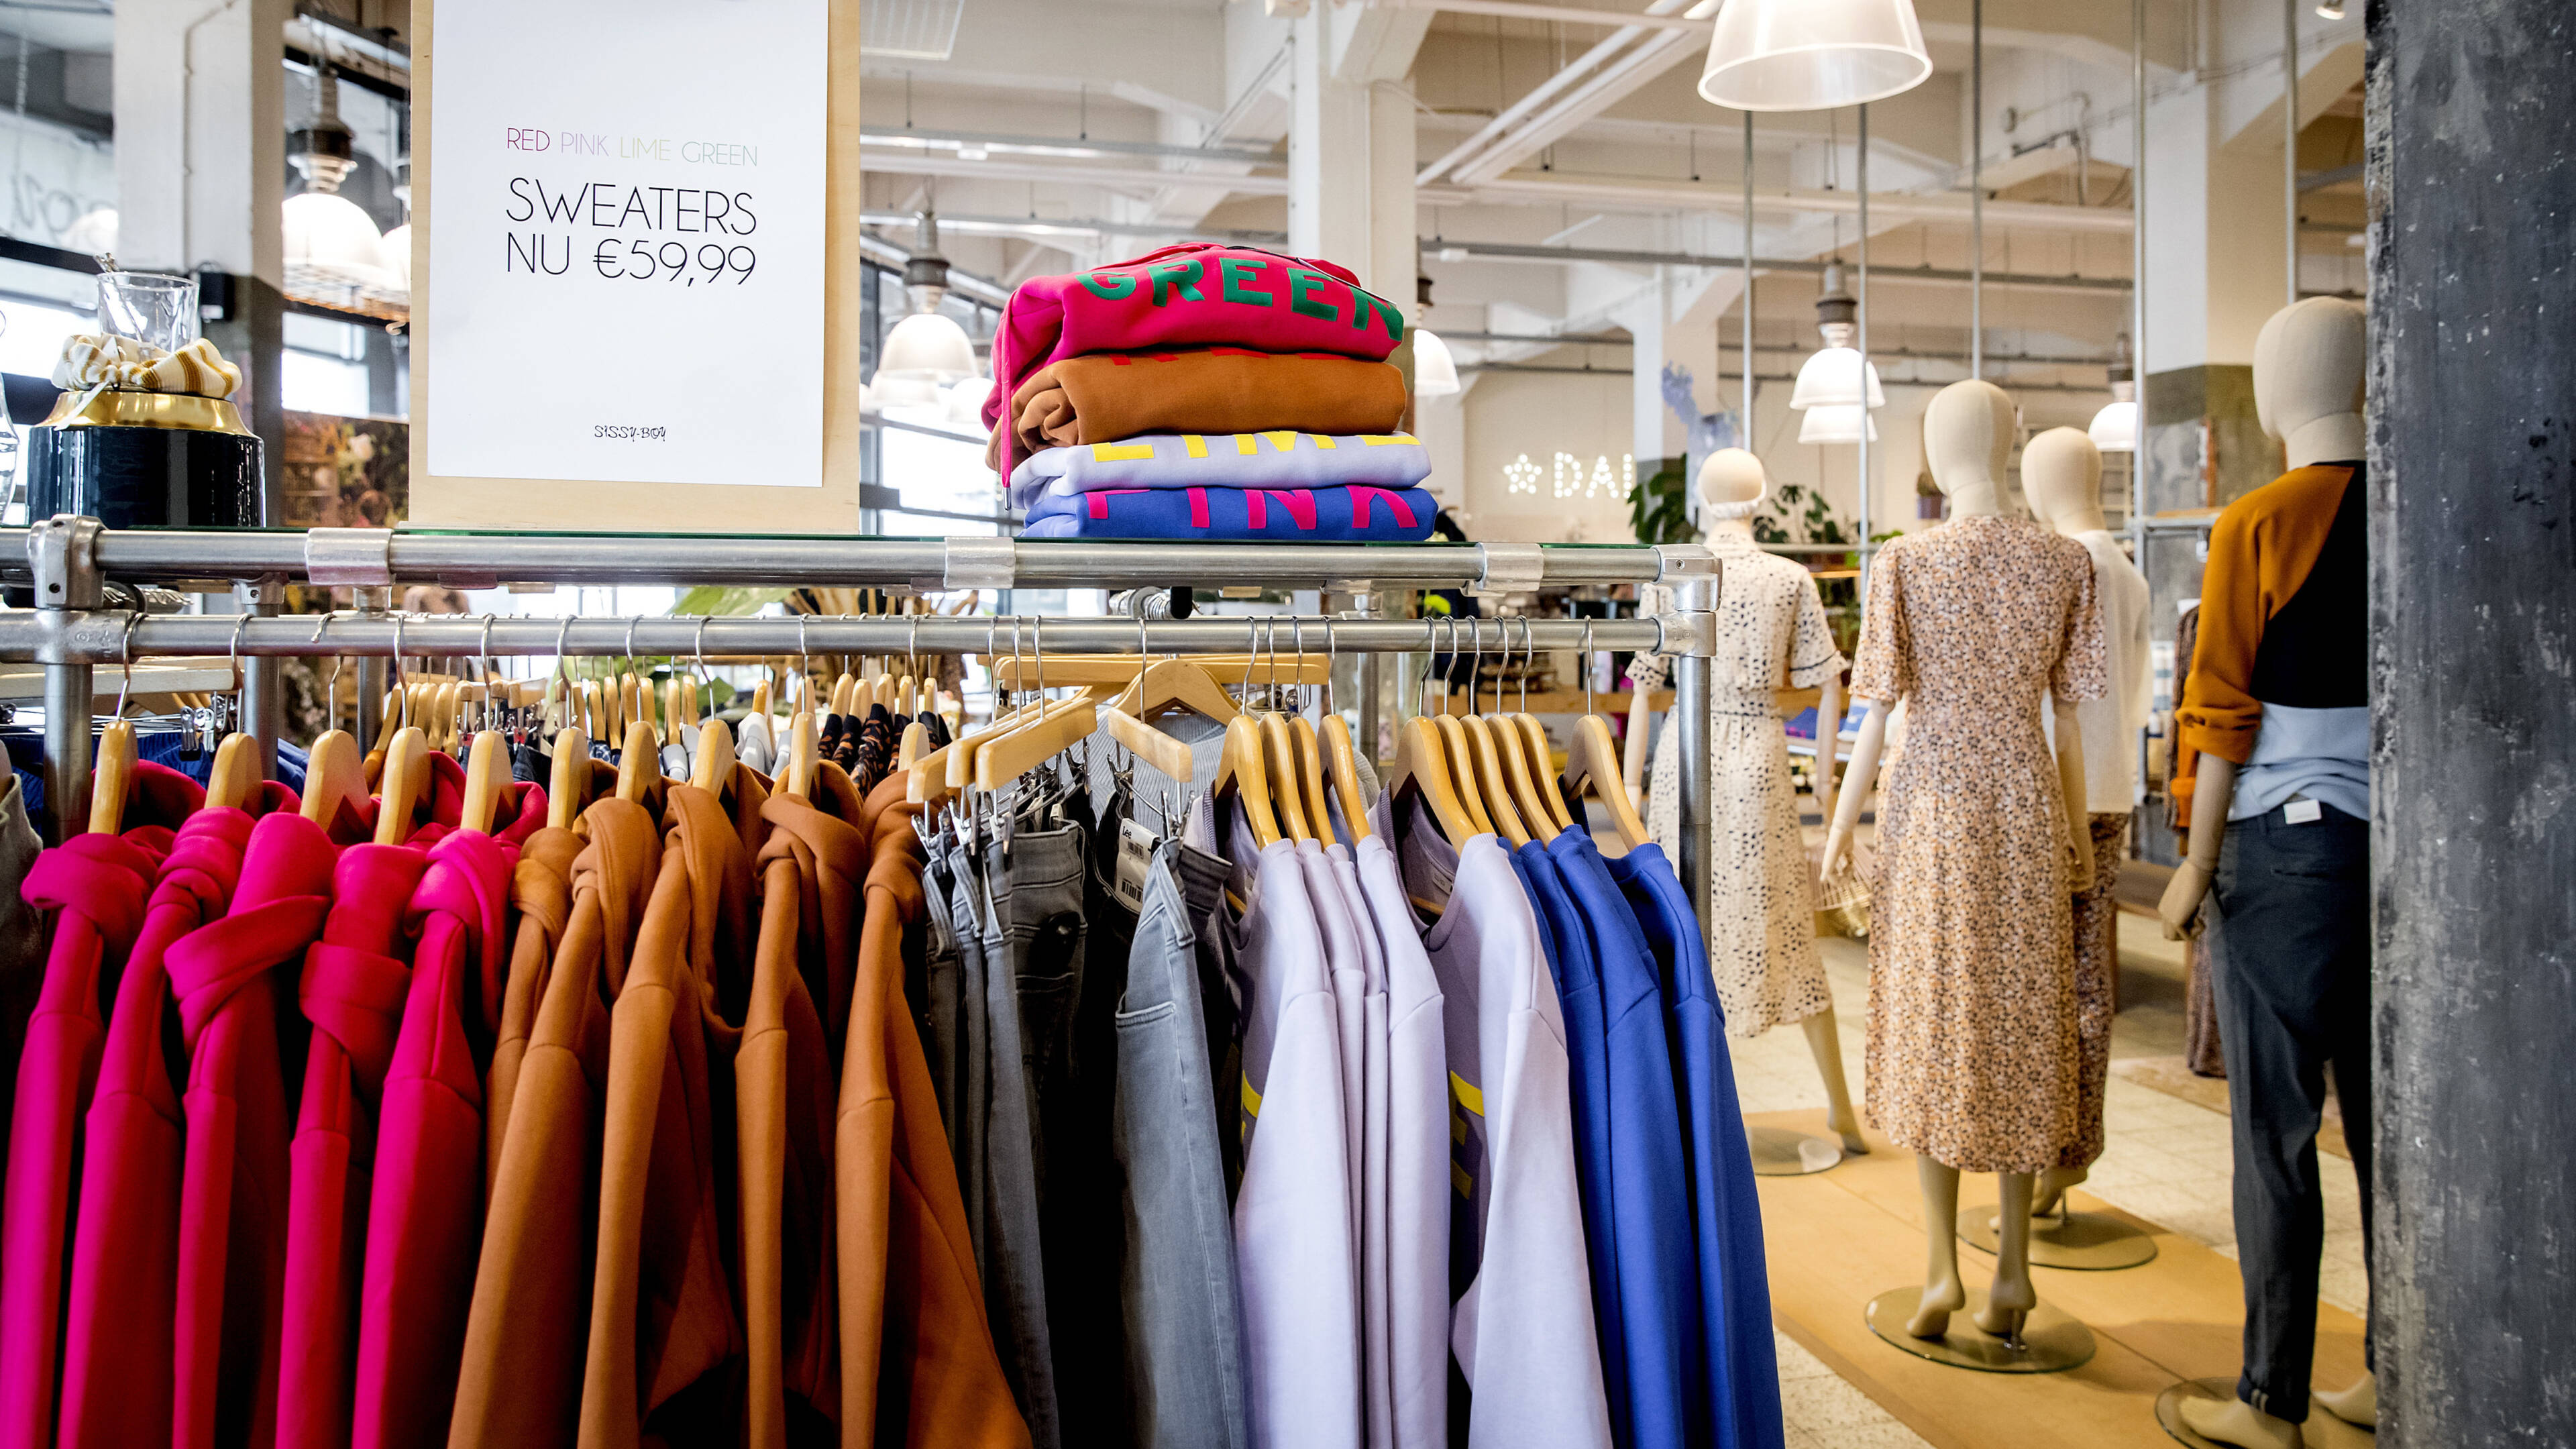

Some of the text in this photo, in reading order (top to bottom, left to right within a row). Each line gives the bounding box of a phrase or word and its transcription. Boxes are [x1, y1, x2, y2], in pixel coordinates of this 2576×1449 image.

[507, 127, 757, 166] RED PINK LIME GREEN
[506, 177, 756, 235] SWEATERS
[508, 232, 755, 287] NU €59,99
[594, 425, 665, 442] SISSY-BOY
[1122, 826, 1132, 840] Lee
